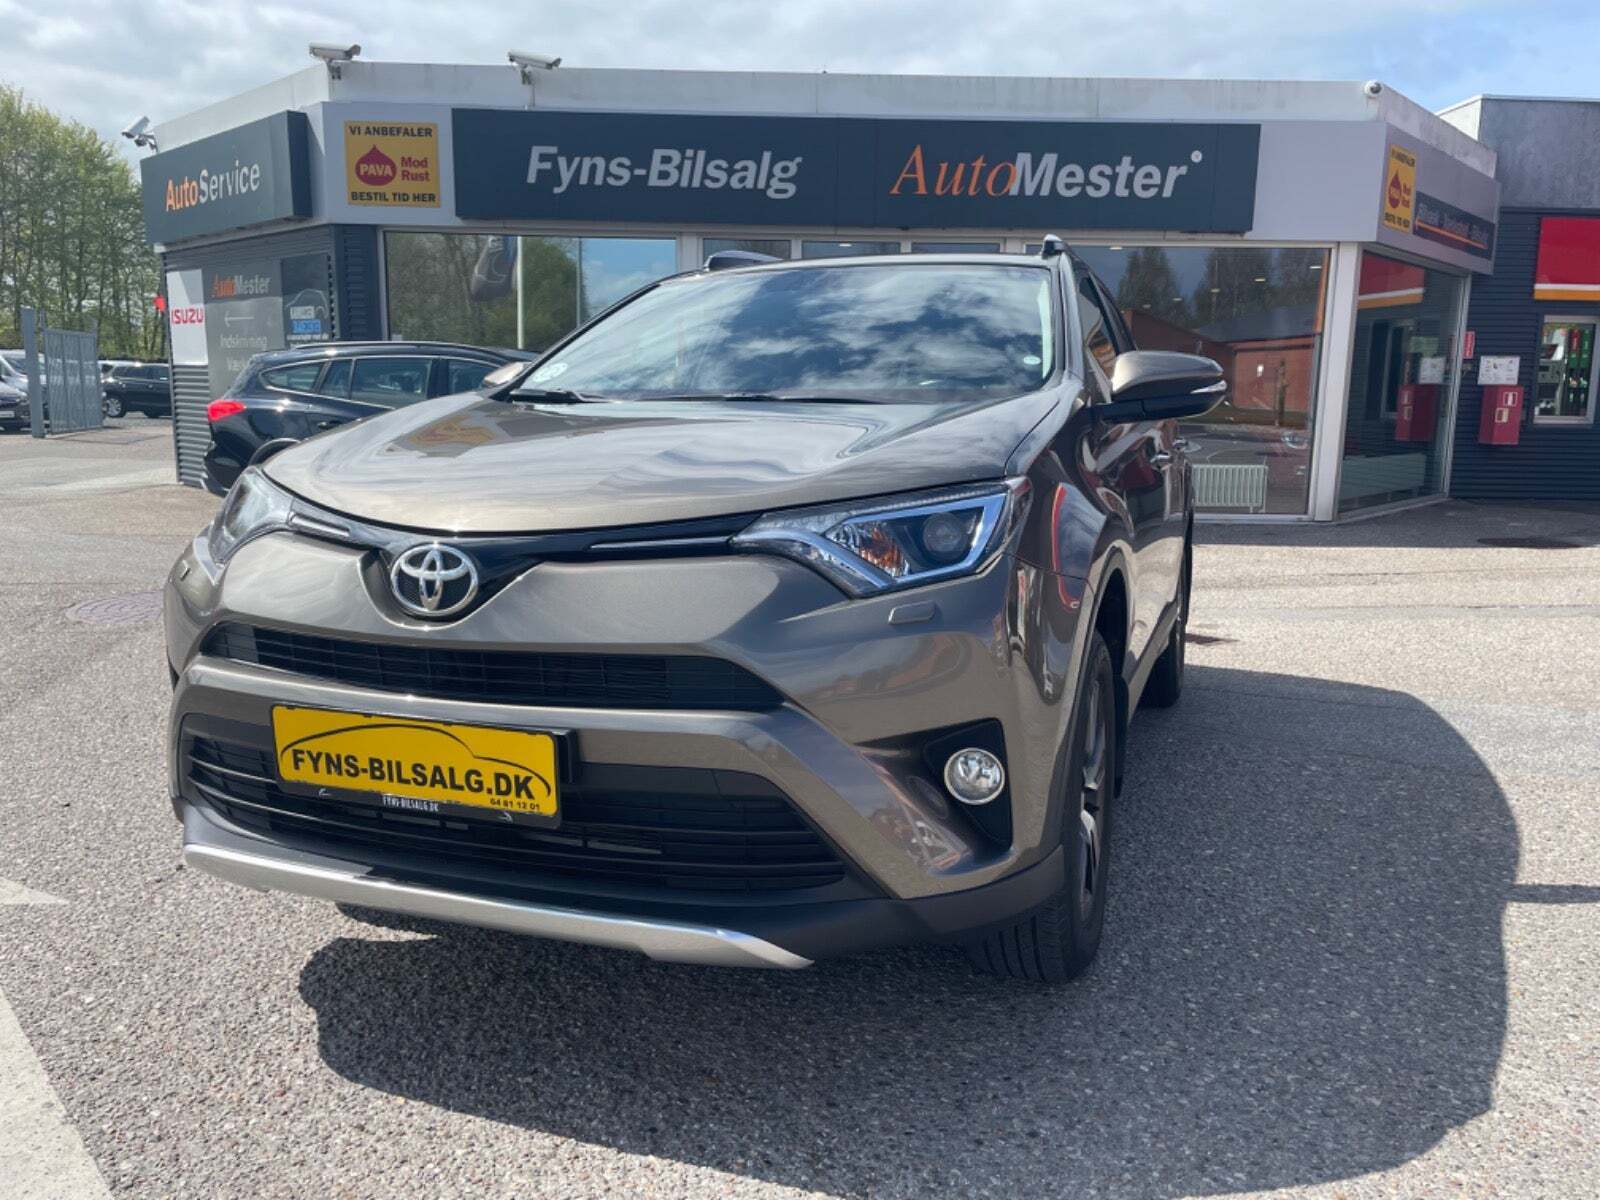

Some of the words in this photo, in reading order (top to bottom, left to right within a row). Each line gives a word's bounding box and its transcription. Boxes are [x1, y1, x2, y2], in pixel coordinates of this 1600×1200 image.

[349, 126, 363, 136] VI
[365, 126, 433, 138] ANBEFALER
[360, 163, 393, 177] PAVA
[401, 156, 429, 169] Mod
[401, 169, 431, 183] Rust
[526, 145, 803, 200] Fyns-Bilsalg
[889, 144, 1188, 199] AutoMester
[165, 159, 261, 212] AutoService
[351, 191, 389, 202] BESTIL
[392, 192, 410, 203] TID
[412, 193, 436, 203] HER
[171, 307, 204, 325] ISUZU
[292, 749, 535, 800] FYNS-BILSALG.DK
